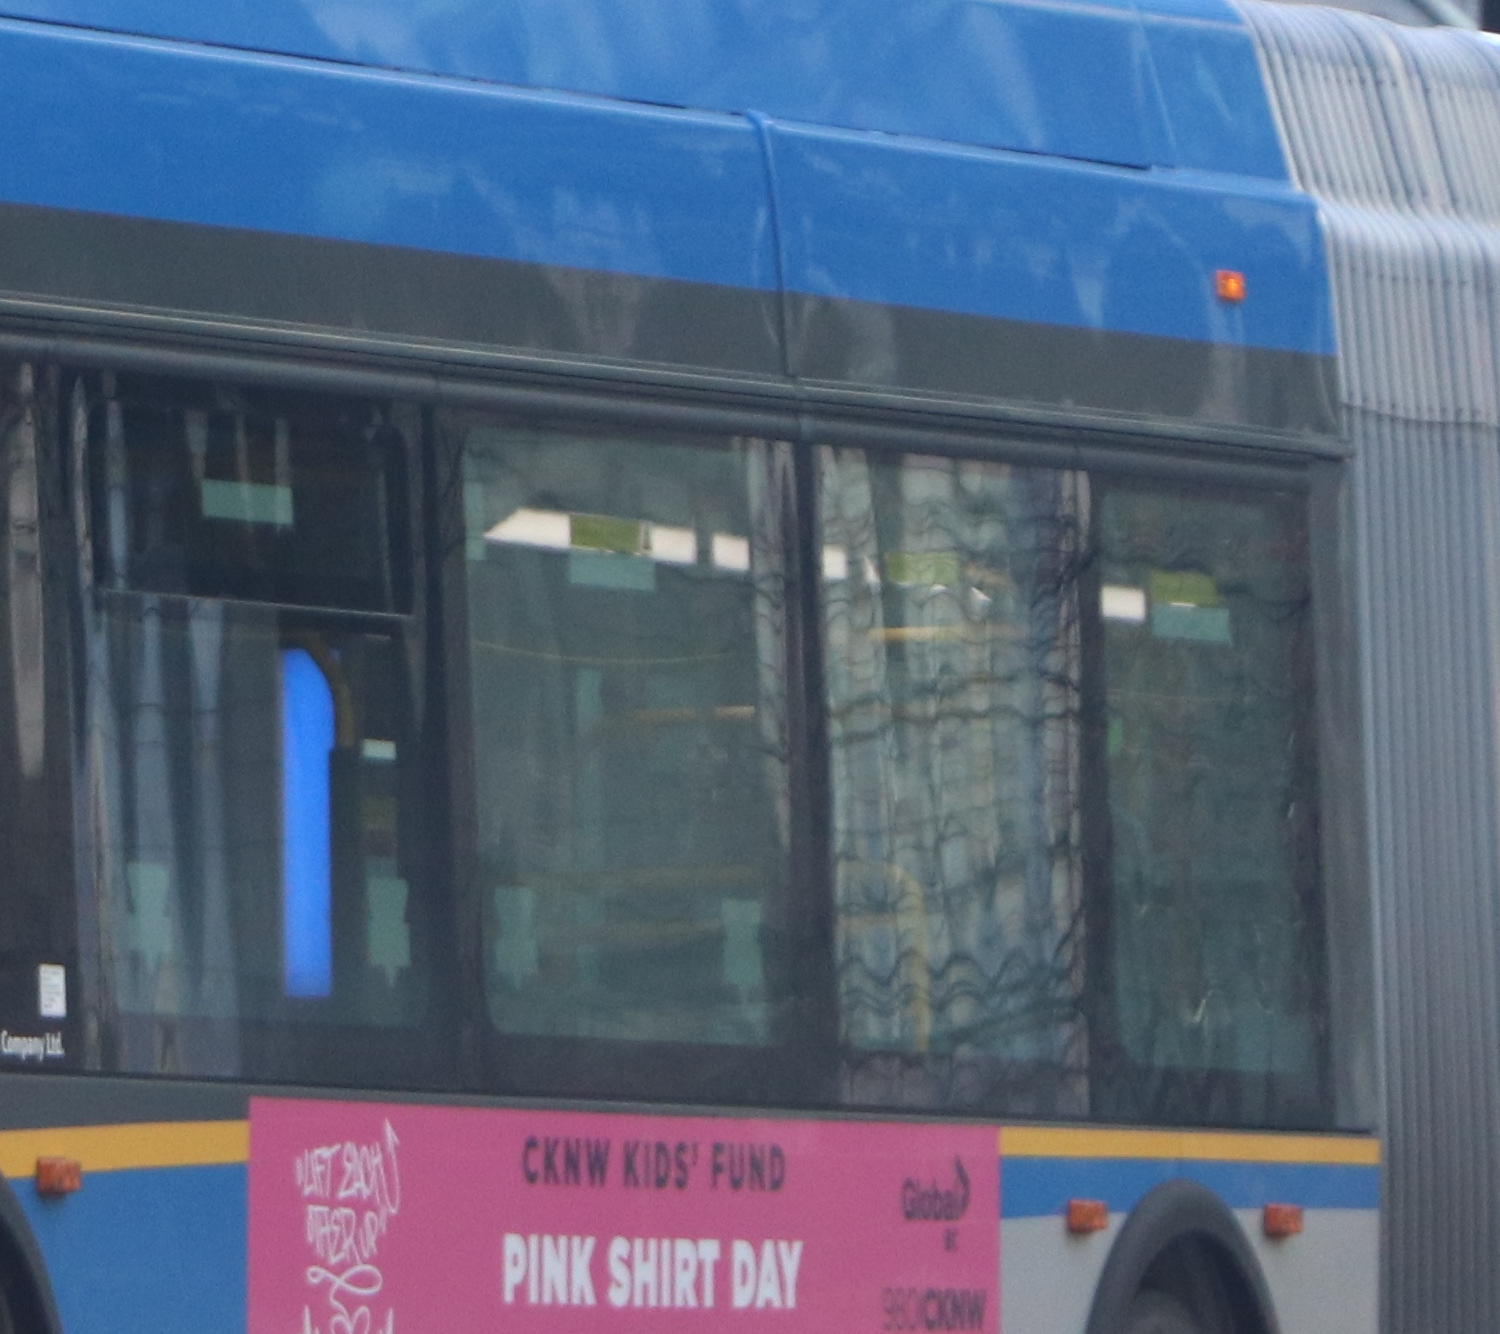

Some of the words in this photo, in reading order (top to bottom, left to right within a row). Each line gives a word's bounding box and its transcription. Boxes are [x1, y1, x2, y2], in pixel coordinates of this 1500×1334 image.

[1, 1030, 44, 1062] Company
[523, 1135, 610, 1188] CKNW
[623, 1139, 699, 1190] KIDS'
[711, 1141, 785, 1192] FUND
[503, 1232, 598, 1306] PINK
[606, 1235, 721, 1309] SHIRT
[731, 1238, 804, 1310] DAY
